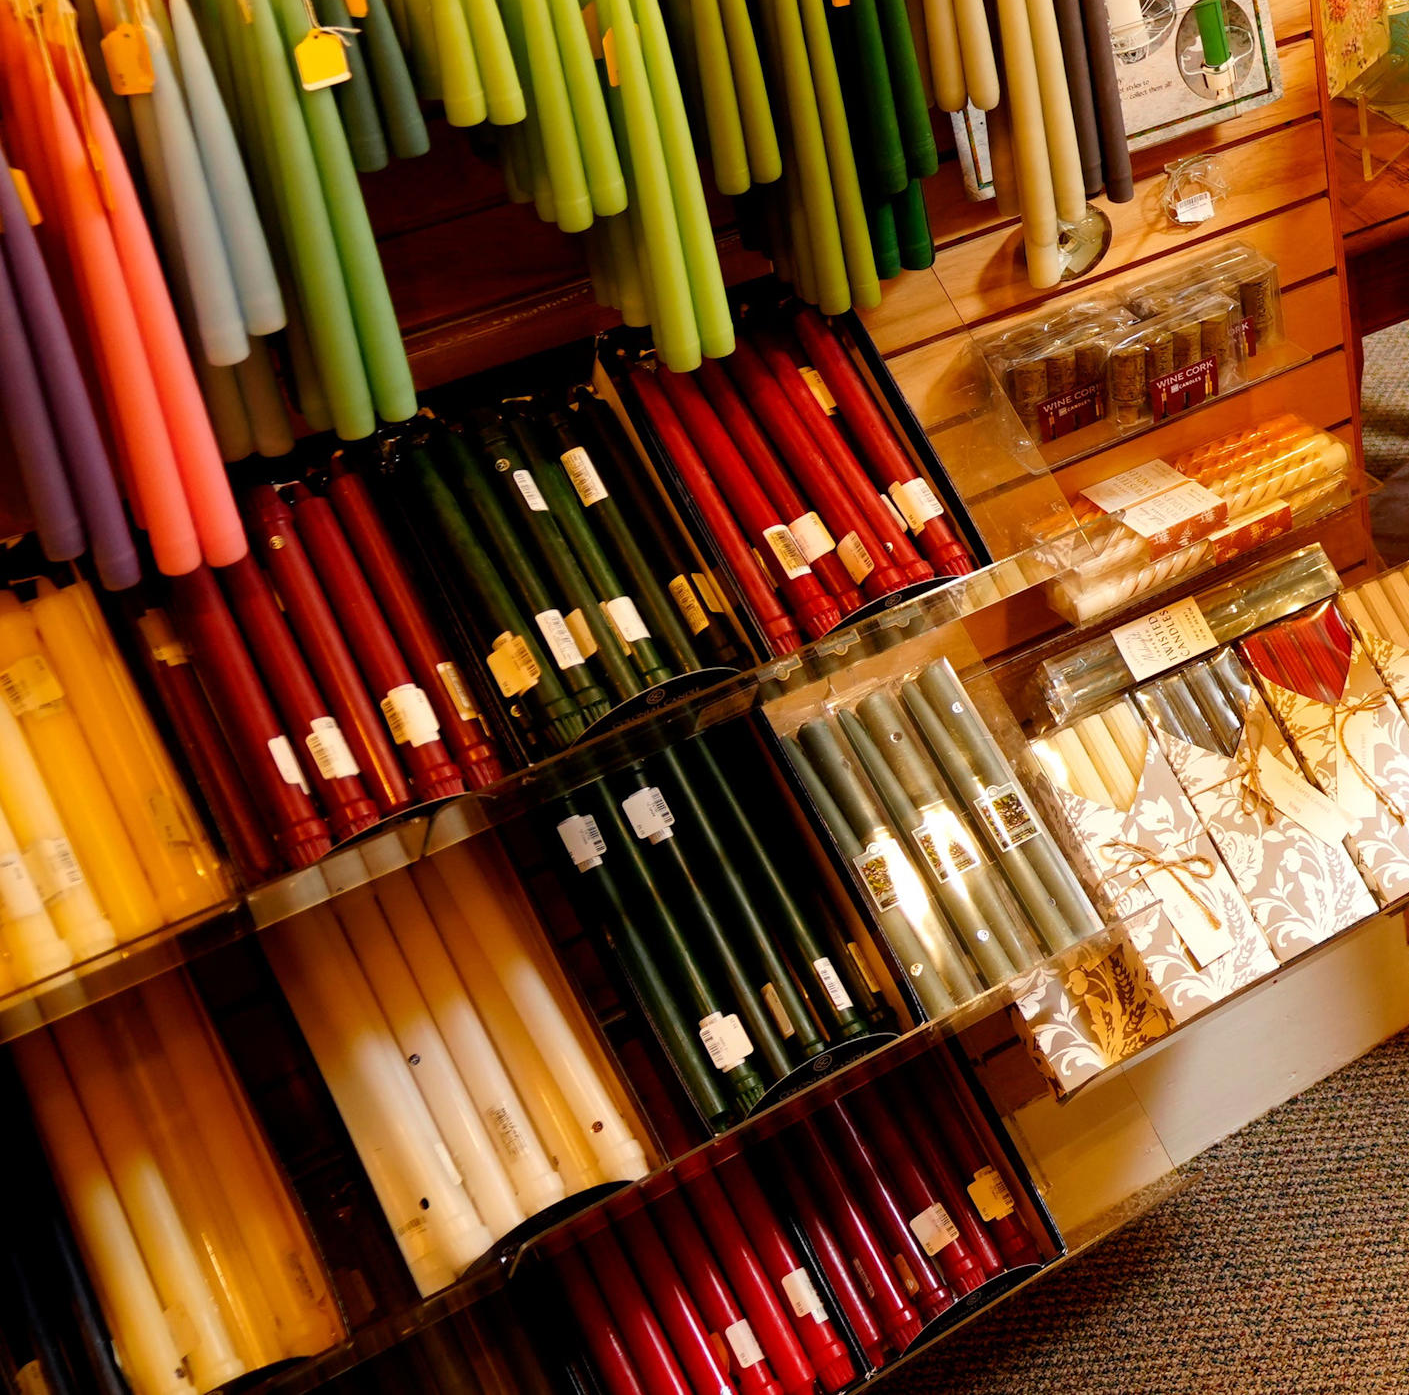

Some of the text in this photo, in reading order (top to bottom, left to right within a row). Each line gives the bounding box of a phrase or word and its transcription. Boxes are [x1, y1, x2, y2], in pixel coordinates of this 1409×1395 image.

[1227, 321, 1250, 335] ORK
[1155, 359, 1214, 390] WINE CORK
[1178, 376, 1202, 390] CANDLES
[1042, 395, 1073, 414] WINE
[1066, 398, 1091, 413] CANDLES
[1148, 615, 1178, 662] TWISTED
[1159, 609, 1191, 657] CANDLES
